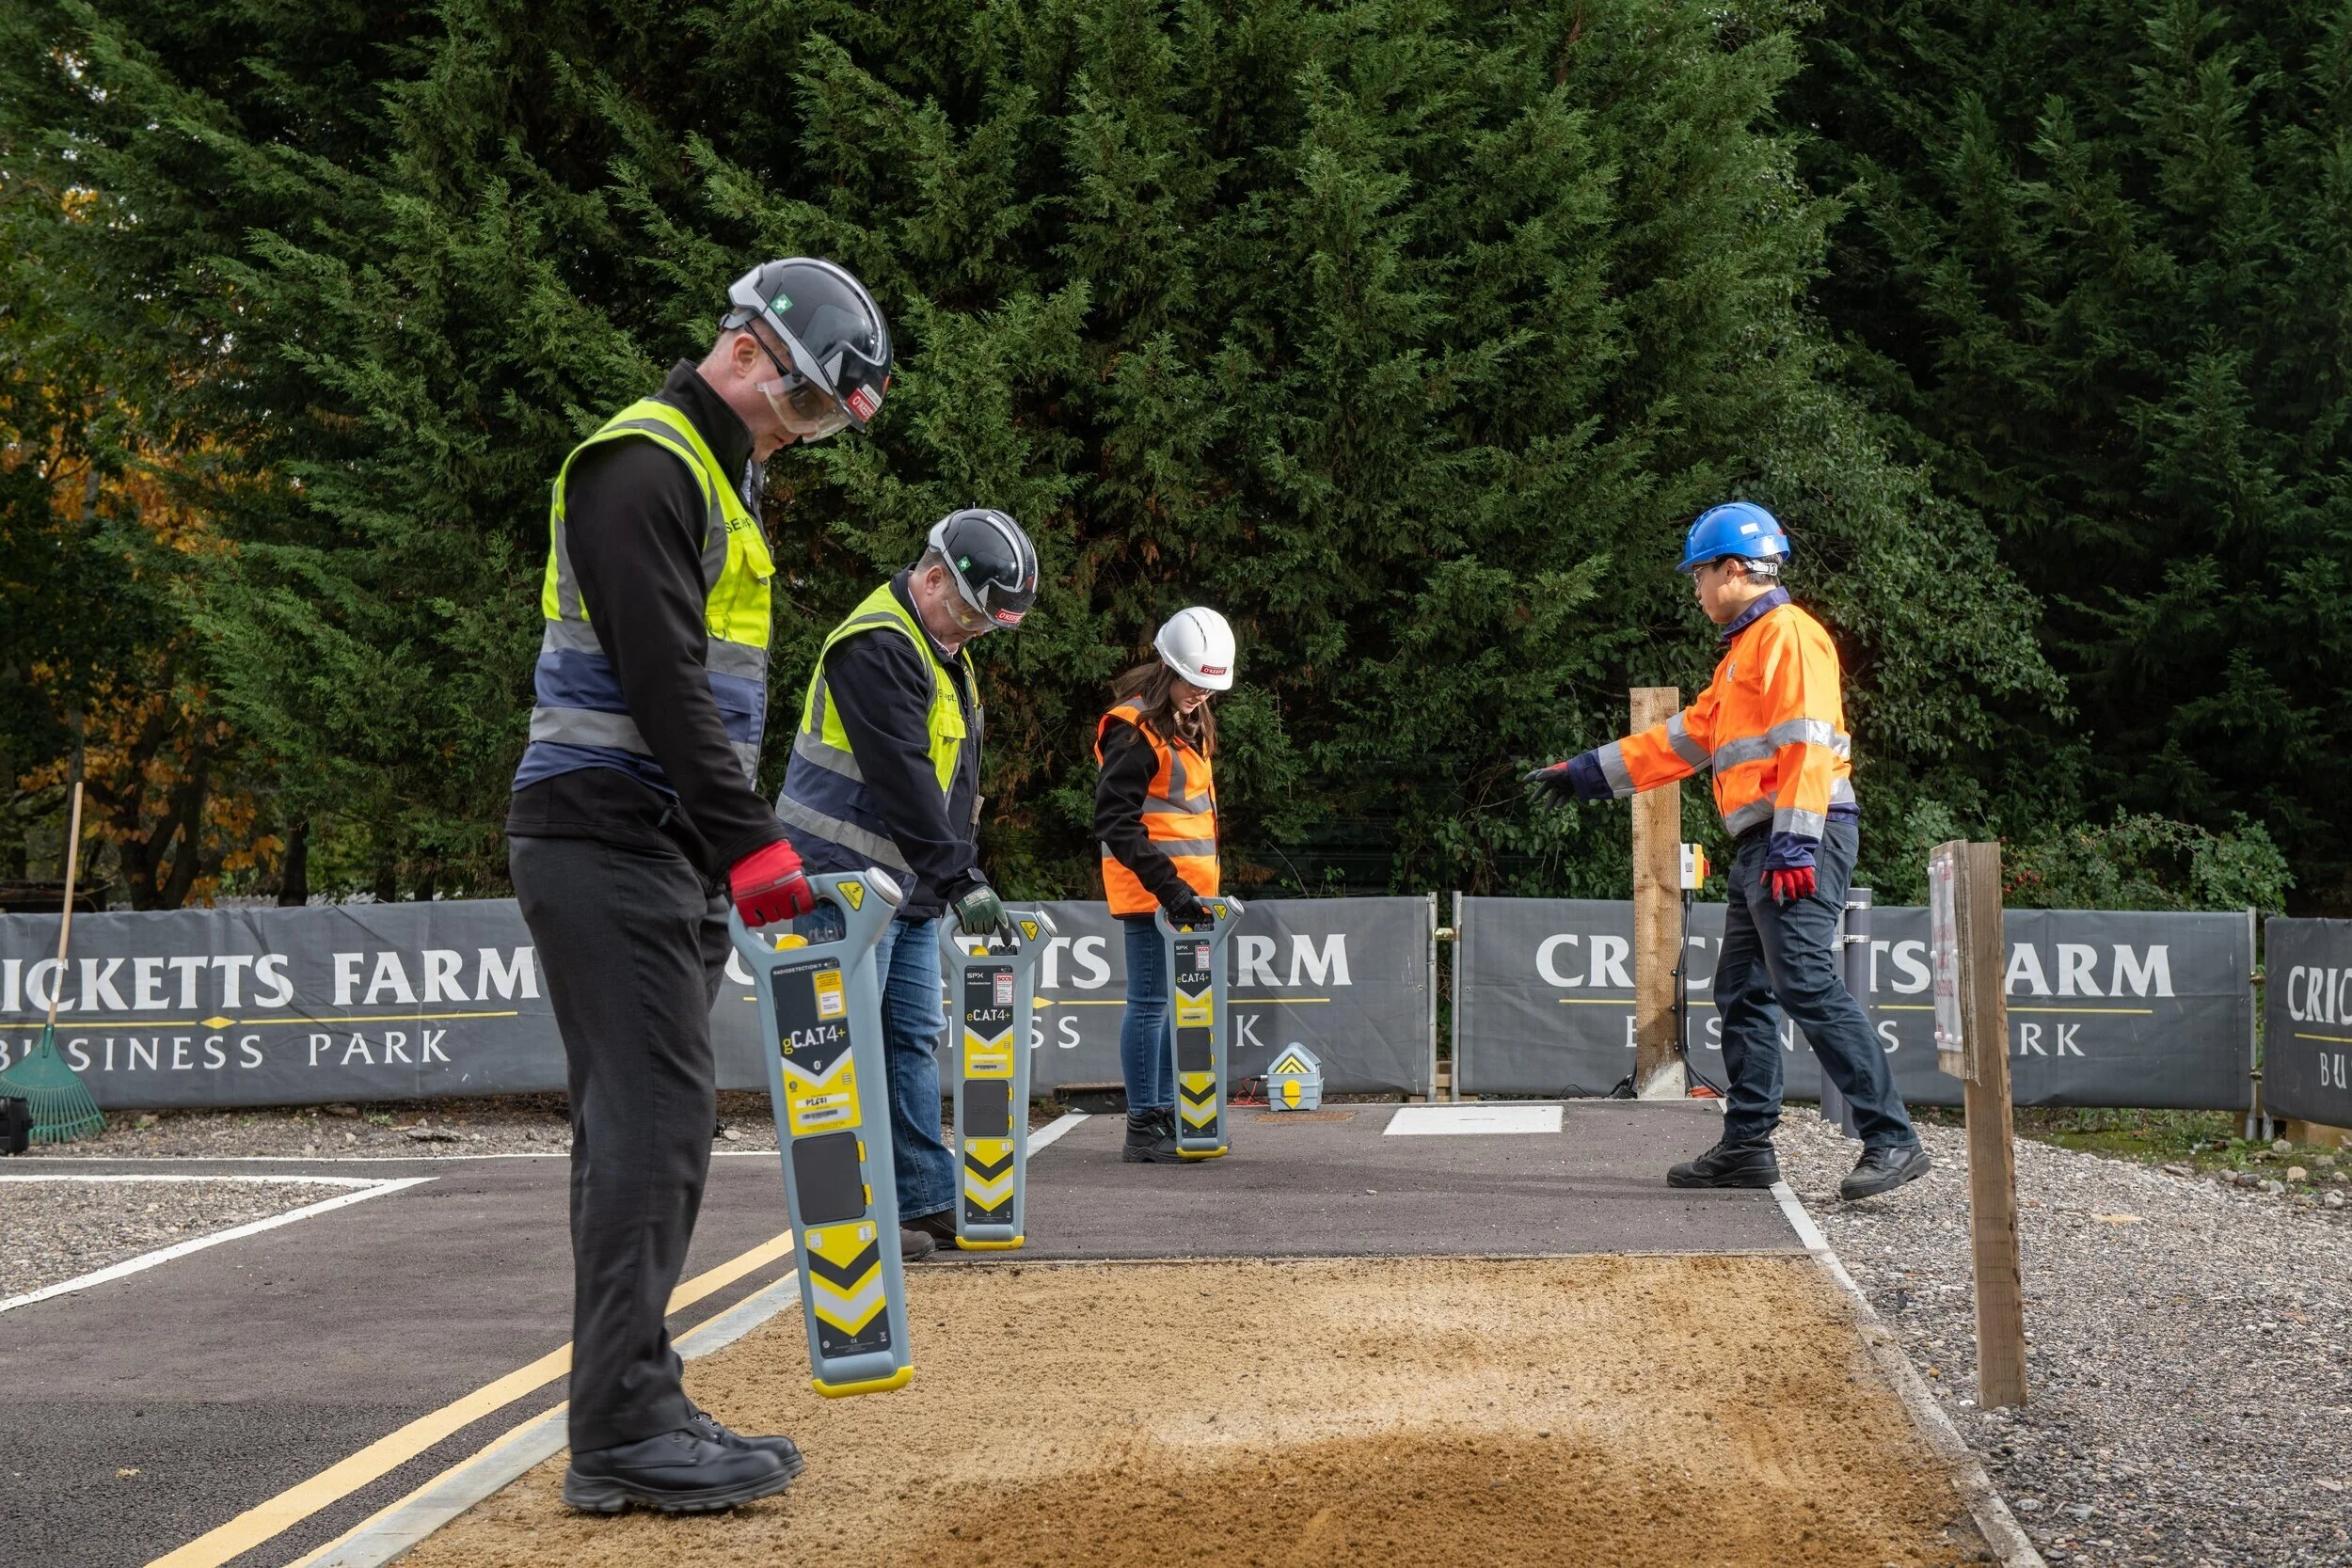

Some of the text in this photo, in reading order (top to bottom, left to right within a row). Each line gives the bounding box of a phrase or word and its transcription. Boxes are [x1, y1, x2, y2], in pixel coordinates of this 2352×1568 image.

[331, 945, 542, 1006] FARM
[2006, 942, 2175, 998] ARM
[308, 1029, 452, 1067] PARK
[2020, 1022, 2086, 1057] RK
